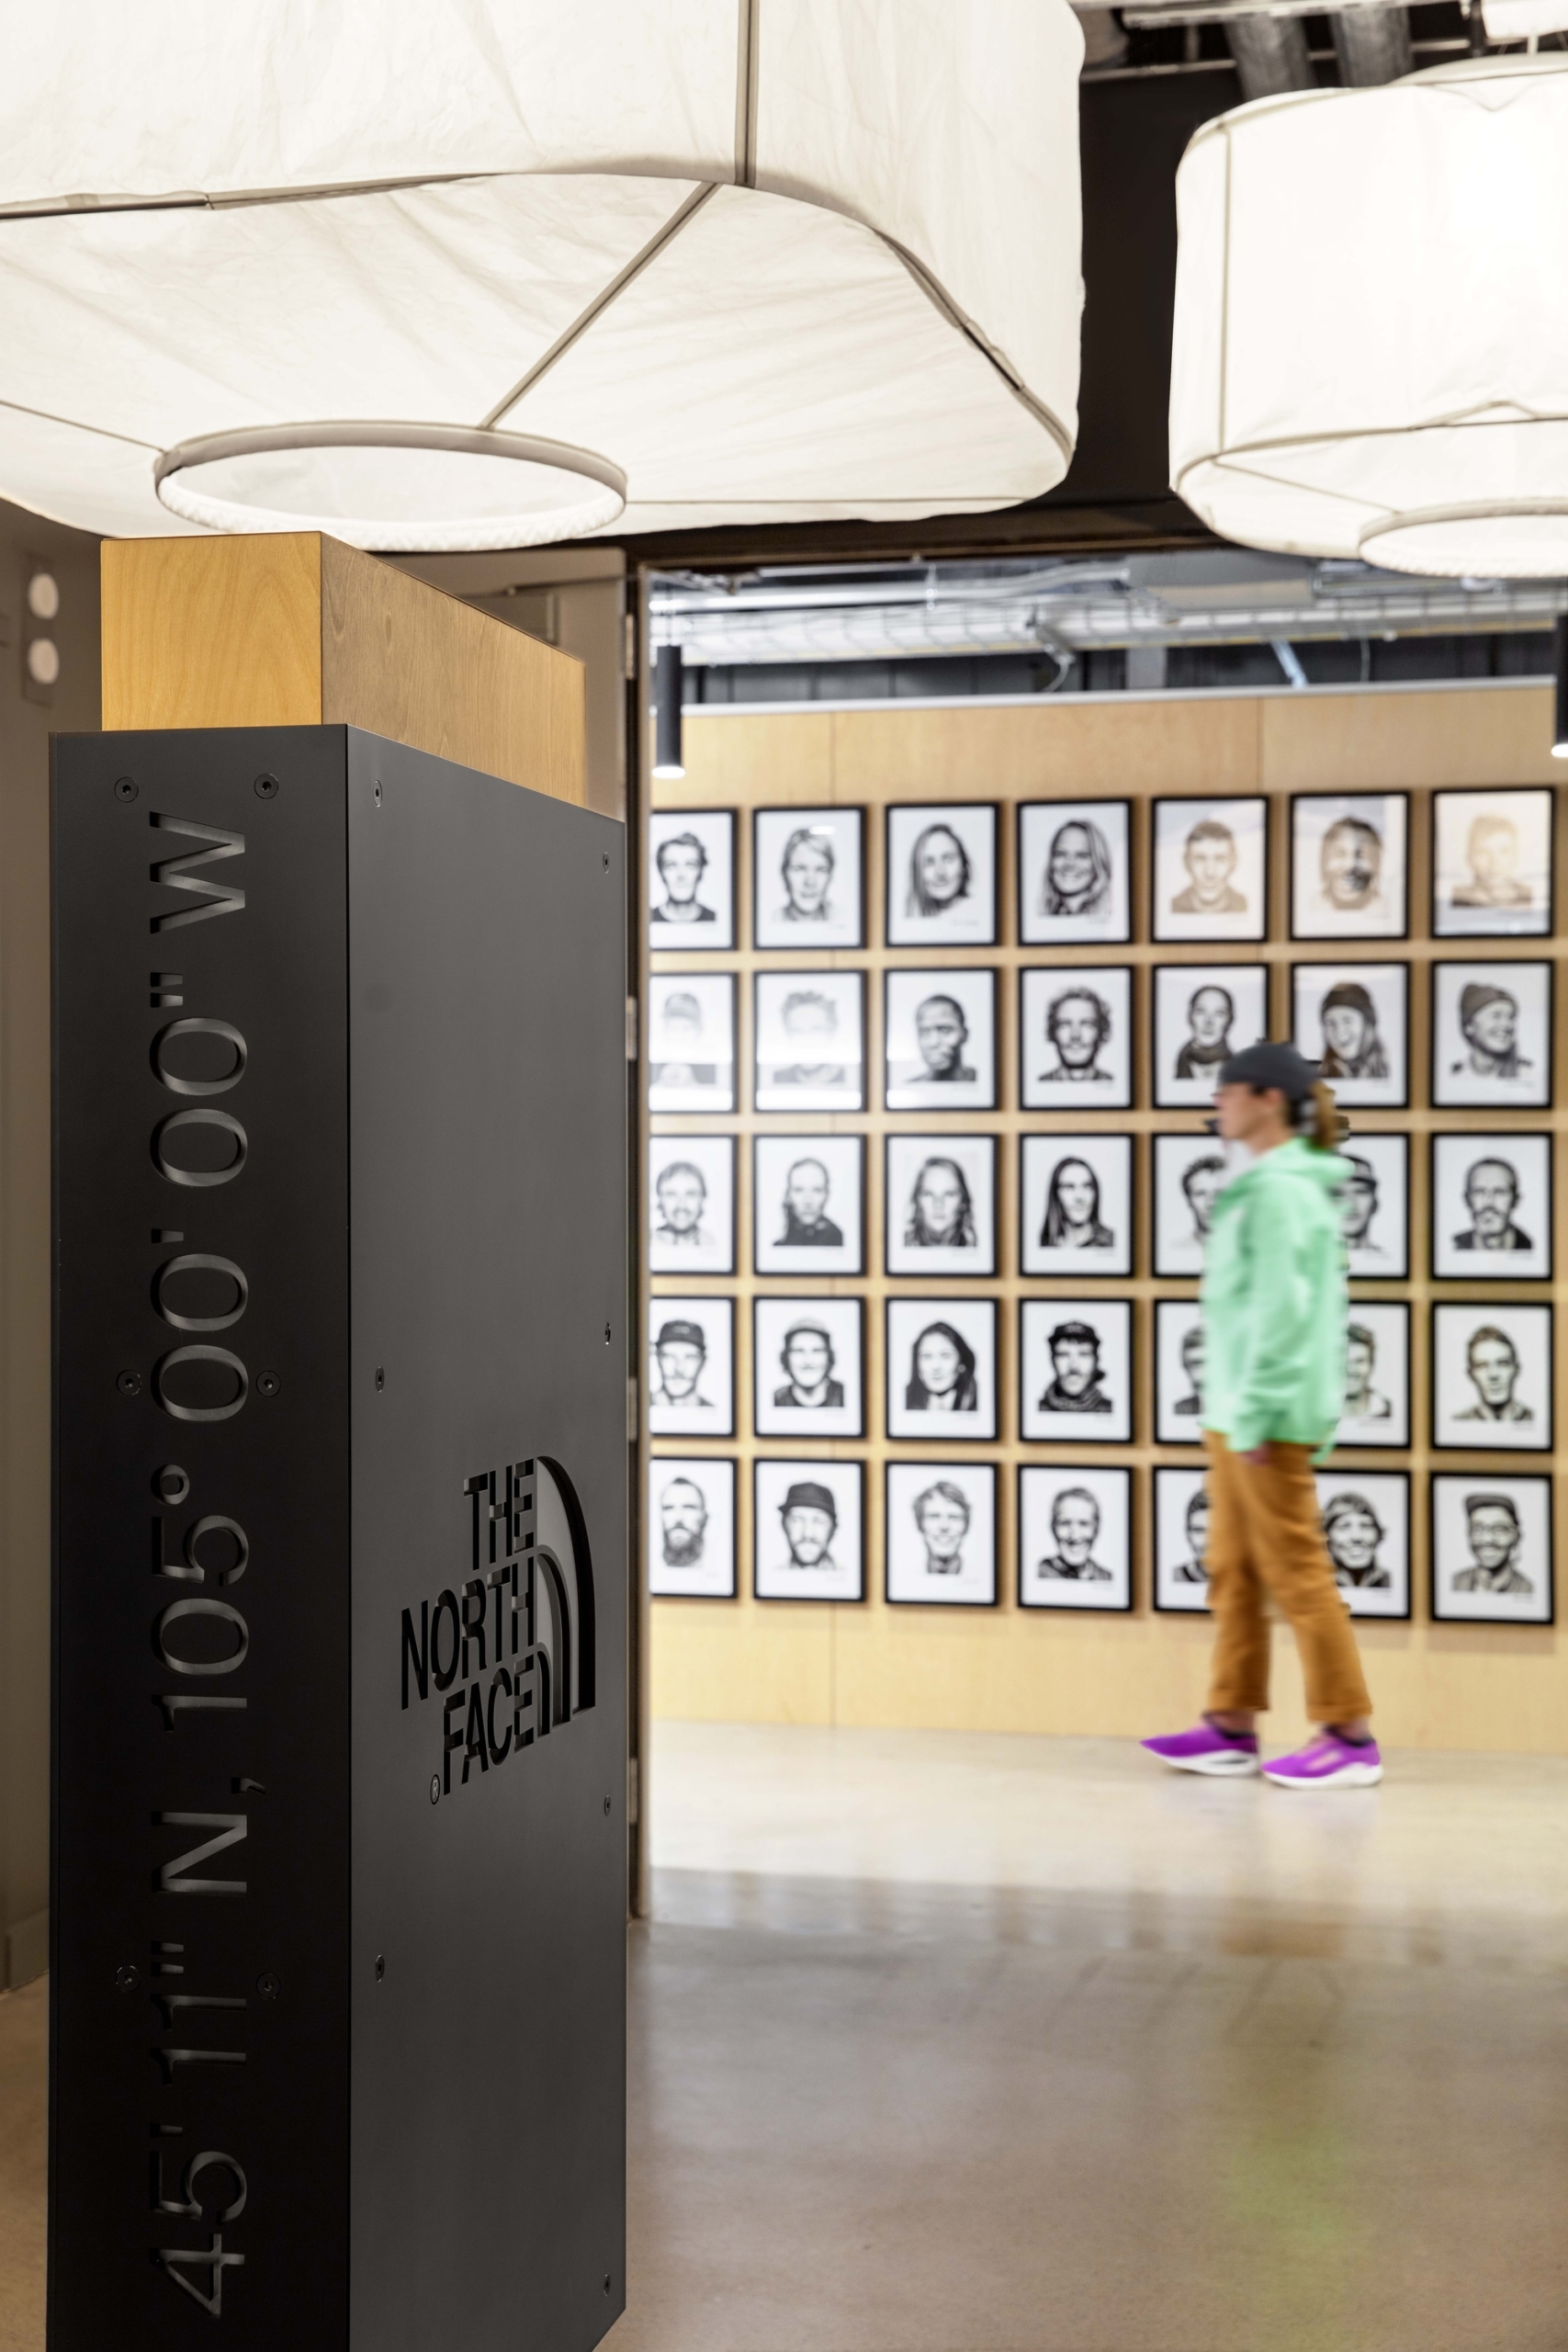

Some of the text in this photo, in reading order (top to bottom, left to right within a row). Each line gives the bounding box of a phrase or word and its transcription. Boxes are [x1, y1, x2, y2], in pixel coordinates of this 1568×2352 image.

[150, 811, 245, 934] W
[464, 1458, 535, 1571] THE
[401, 1556, 535, 1711] NORTH
[443, 1654, 535, 1796] FACE
[151, 1777, 265, 1896] N,
